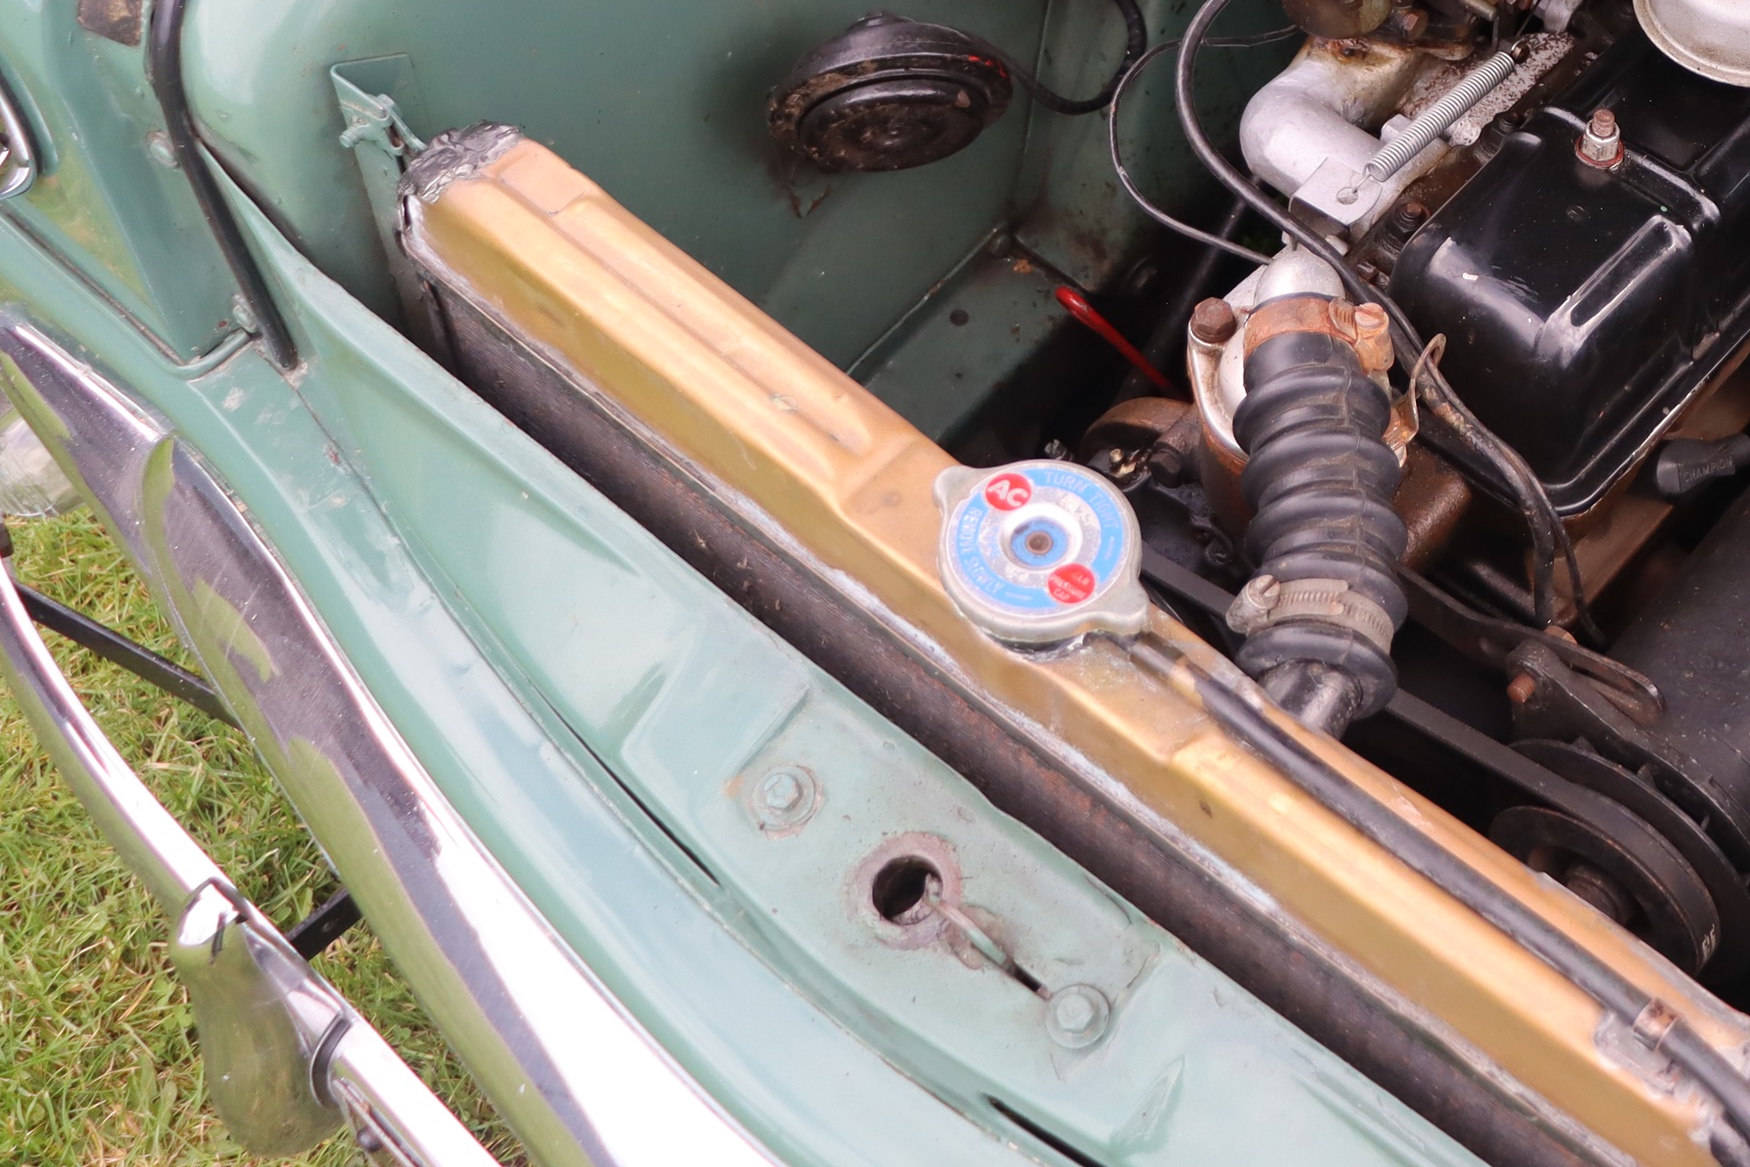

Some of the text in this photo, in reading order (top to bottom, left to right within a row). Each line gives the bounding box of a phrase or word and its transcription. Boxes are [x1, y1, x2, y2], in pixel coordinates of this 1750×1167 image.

[987, 479, 1029, 507] AC
[1044, 470, 1120, 529] TURN TIGHT
[959, 507, 1004, 595] REMOVE SLOWLY
[1049, 574, 1087, 601] PRESSURE
[1052, 587, 1071, 602] CAP
